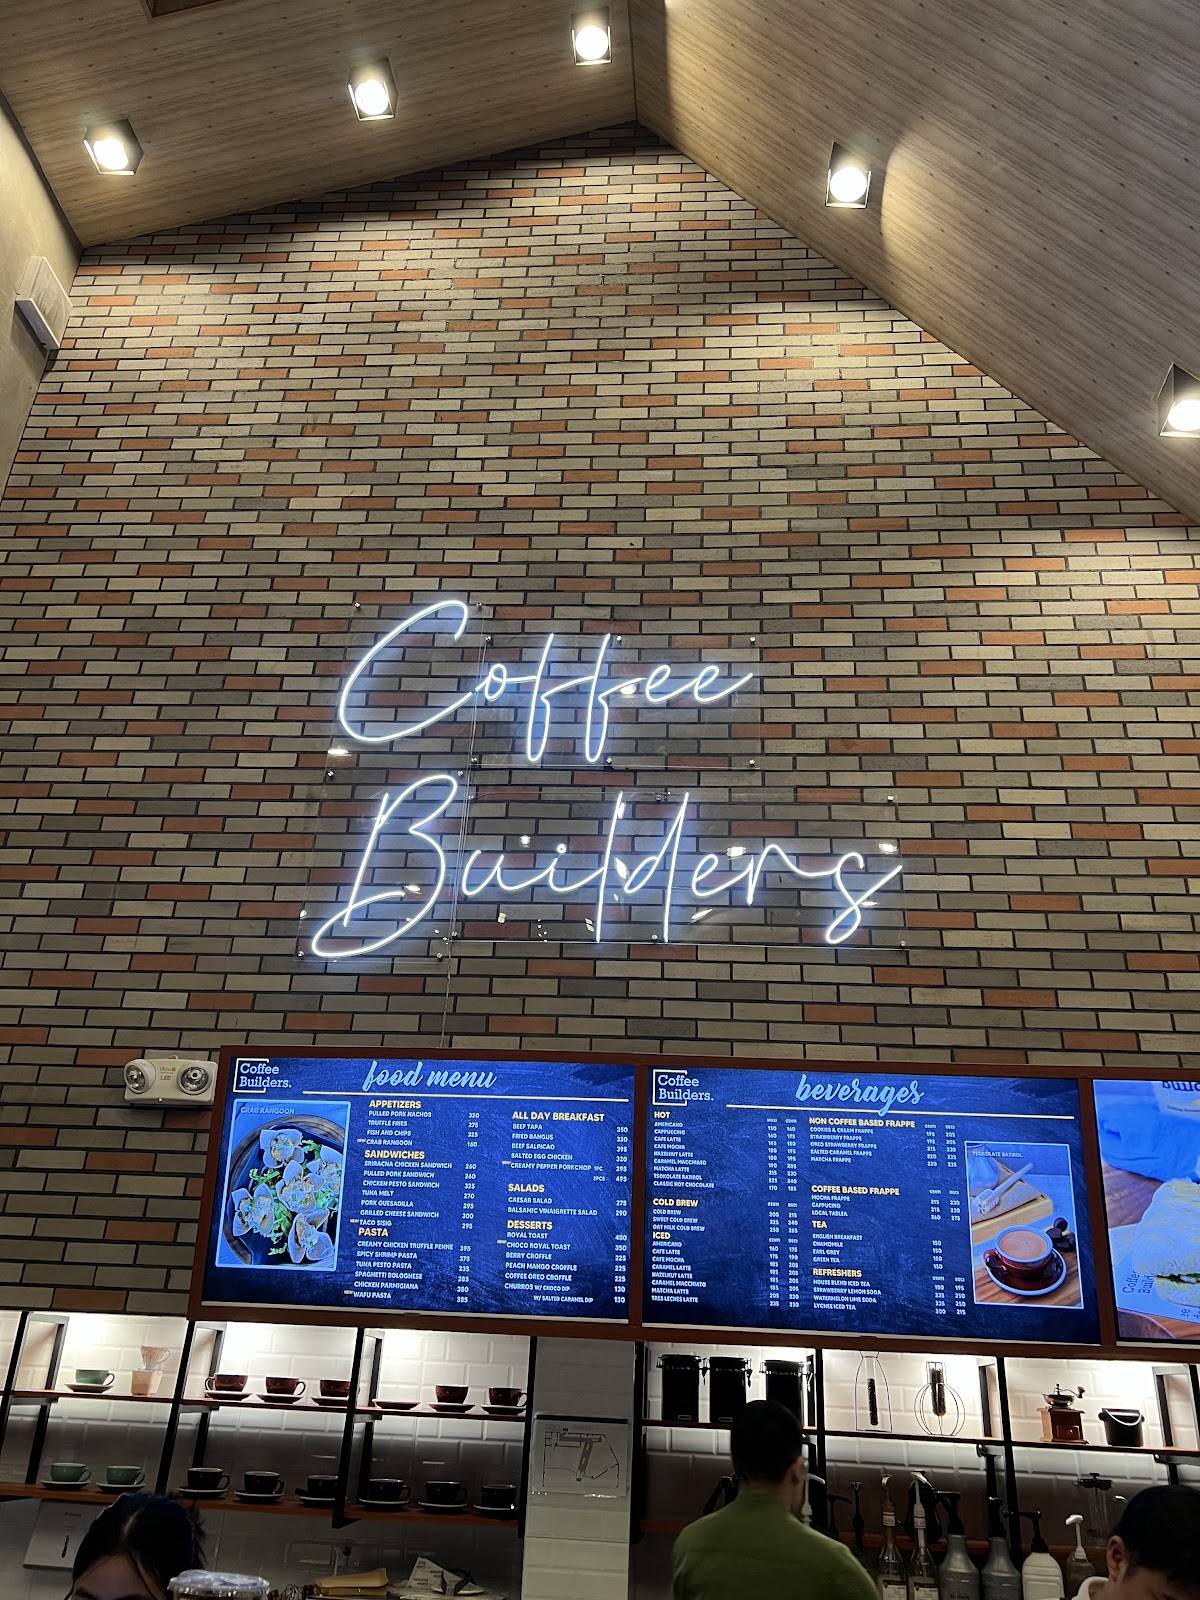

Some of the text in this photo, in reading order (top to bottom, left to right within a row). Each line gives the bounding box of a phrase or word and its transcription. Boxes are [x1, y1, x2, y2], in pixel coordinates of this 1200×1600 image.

[338, 598, 754, 763] Coffee
[311, 774, 903, 958] Builders
[240, 1063, 279, 1074] Coffee
[362, 1061, 497, 1091] food menu
[658, 1075, 699, 1086] Coffee
[239, 1076, 292, 1088] Builders.
[658, 1088, 714, 1100] Builders.
[796, 1074, 924, 1116] beverages
[369, 1100, 421, 1108] APPETIZERS
[531, 1112, 550, 1120] DAY
[553, 1113, 604, 1121] BREAKFAST
[859, 1118, 884, 1127] BASED
[364, 1150, 425, 1159] SANDWICHES
[508, 1184, 544, 1192] SALADS
[812, 1185, 900, 1195] COFFEE BASED FRAPPE
[508, 1220, 552, 1229] DESSERTS
[359, 1228, 388, 1236] PASTA
[813, 1268, 862, 1277] REFRESHERS
